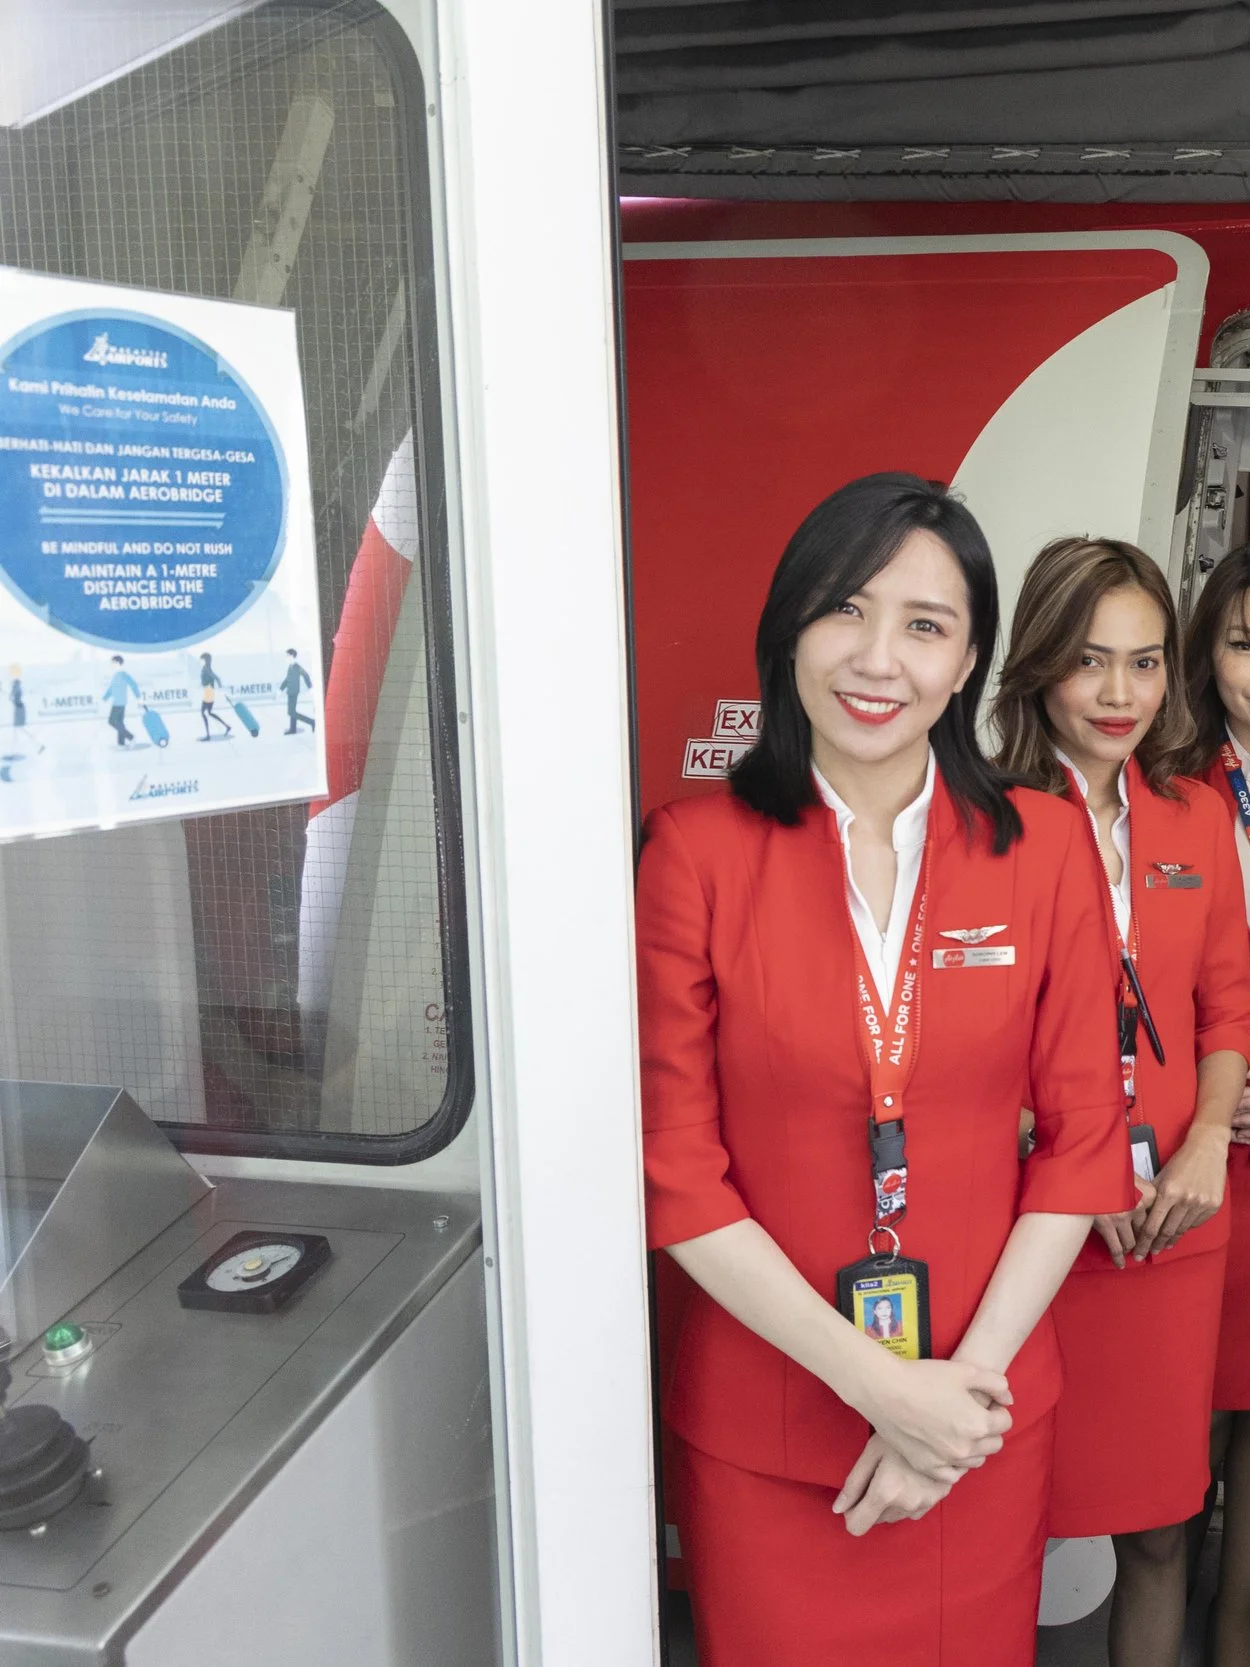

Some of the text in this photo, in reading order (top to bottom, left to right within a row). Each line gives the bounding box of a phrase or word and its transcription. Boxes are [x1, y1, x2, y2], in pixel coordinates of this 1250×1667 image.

[8, 377, 237, 410] Kami Prihatin Keselamatan Anda
[58, 403, 198, 427] We Care for Your Safety
[84, 442, 114, 455] DAN
[117, 444, 170, 458] JANGAN
[172, 448, 256, 464] TERGESA-GESA
[30, 463, 231, 487] KEKALKAN JARAK 1 METER
[43, 482, 223, 503] DI DALAM AEROBRIDGE
[41, 541, 233, 556] BE MINDFUL AND DO NOT RUSH
[64, 564, 218, 579] MAINTAIN A 1-METRE
[83, 580, 204, 596] DISTANCE IN THE
[100, 595, 192, 611] AEROBRIDGE
[142, 689, 189, 702] 1-METER
[229, 683, 273, 695] 1-METER
[42, 695, 94, 709] 1-METER
[863, 1004, 881, 1036] FOR
[889, 971, 916, 1066] ALL FOR ONE
